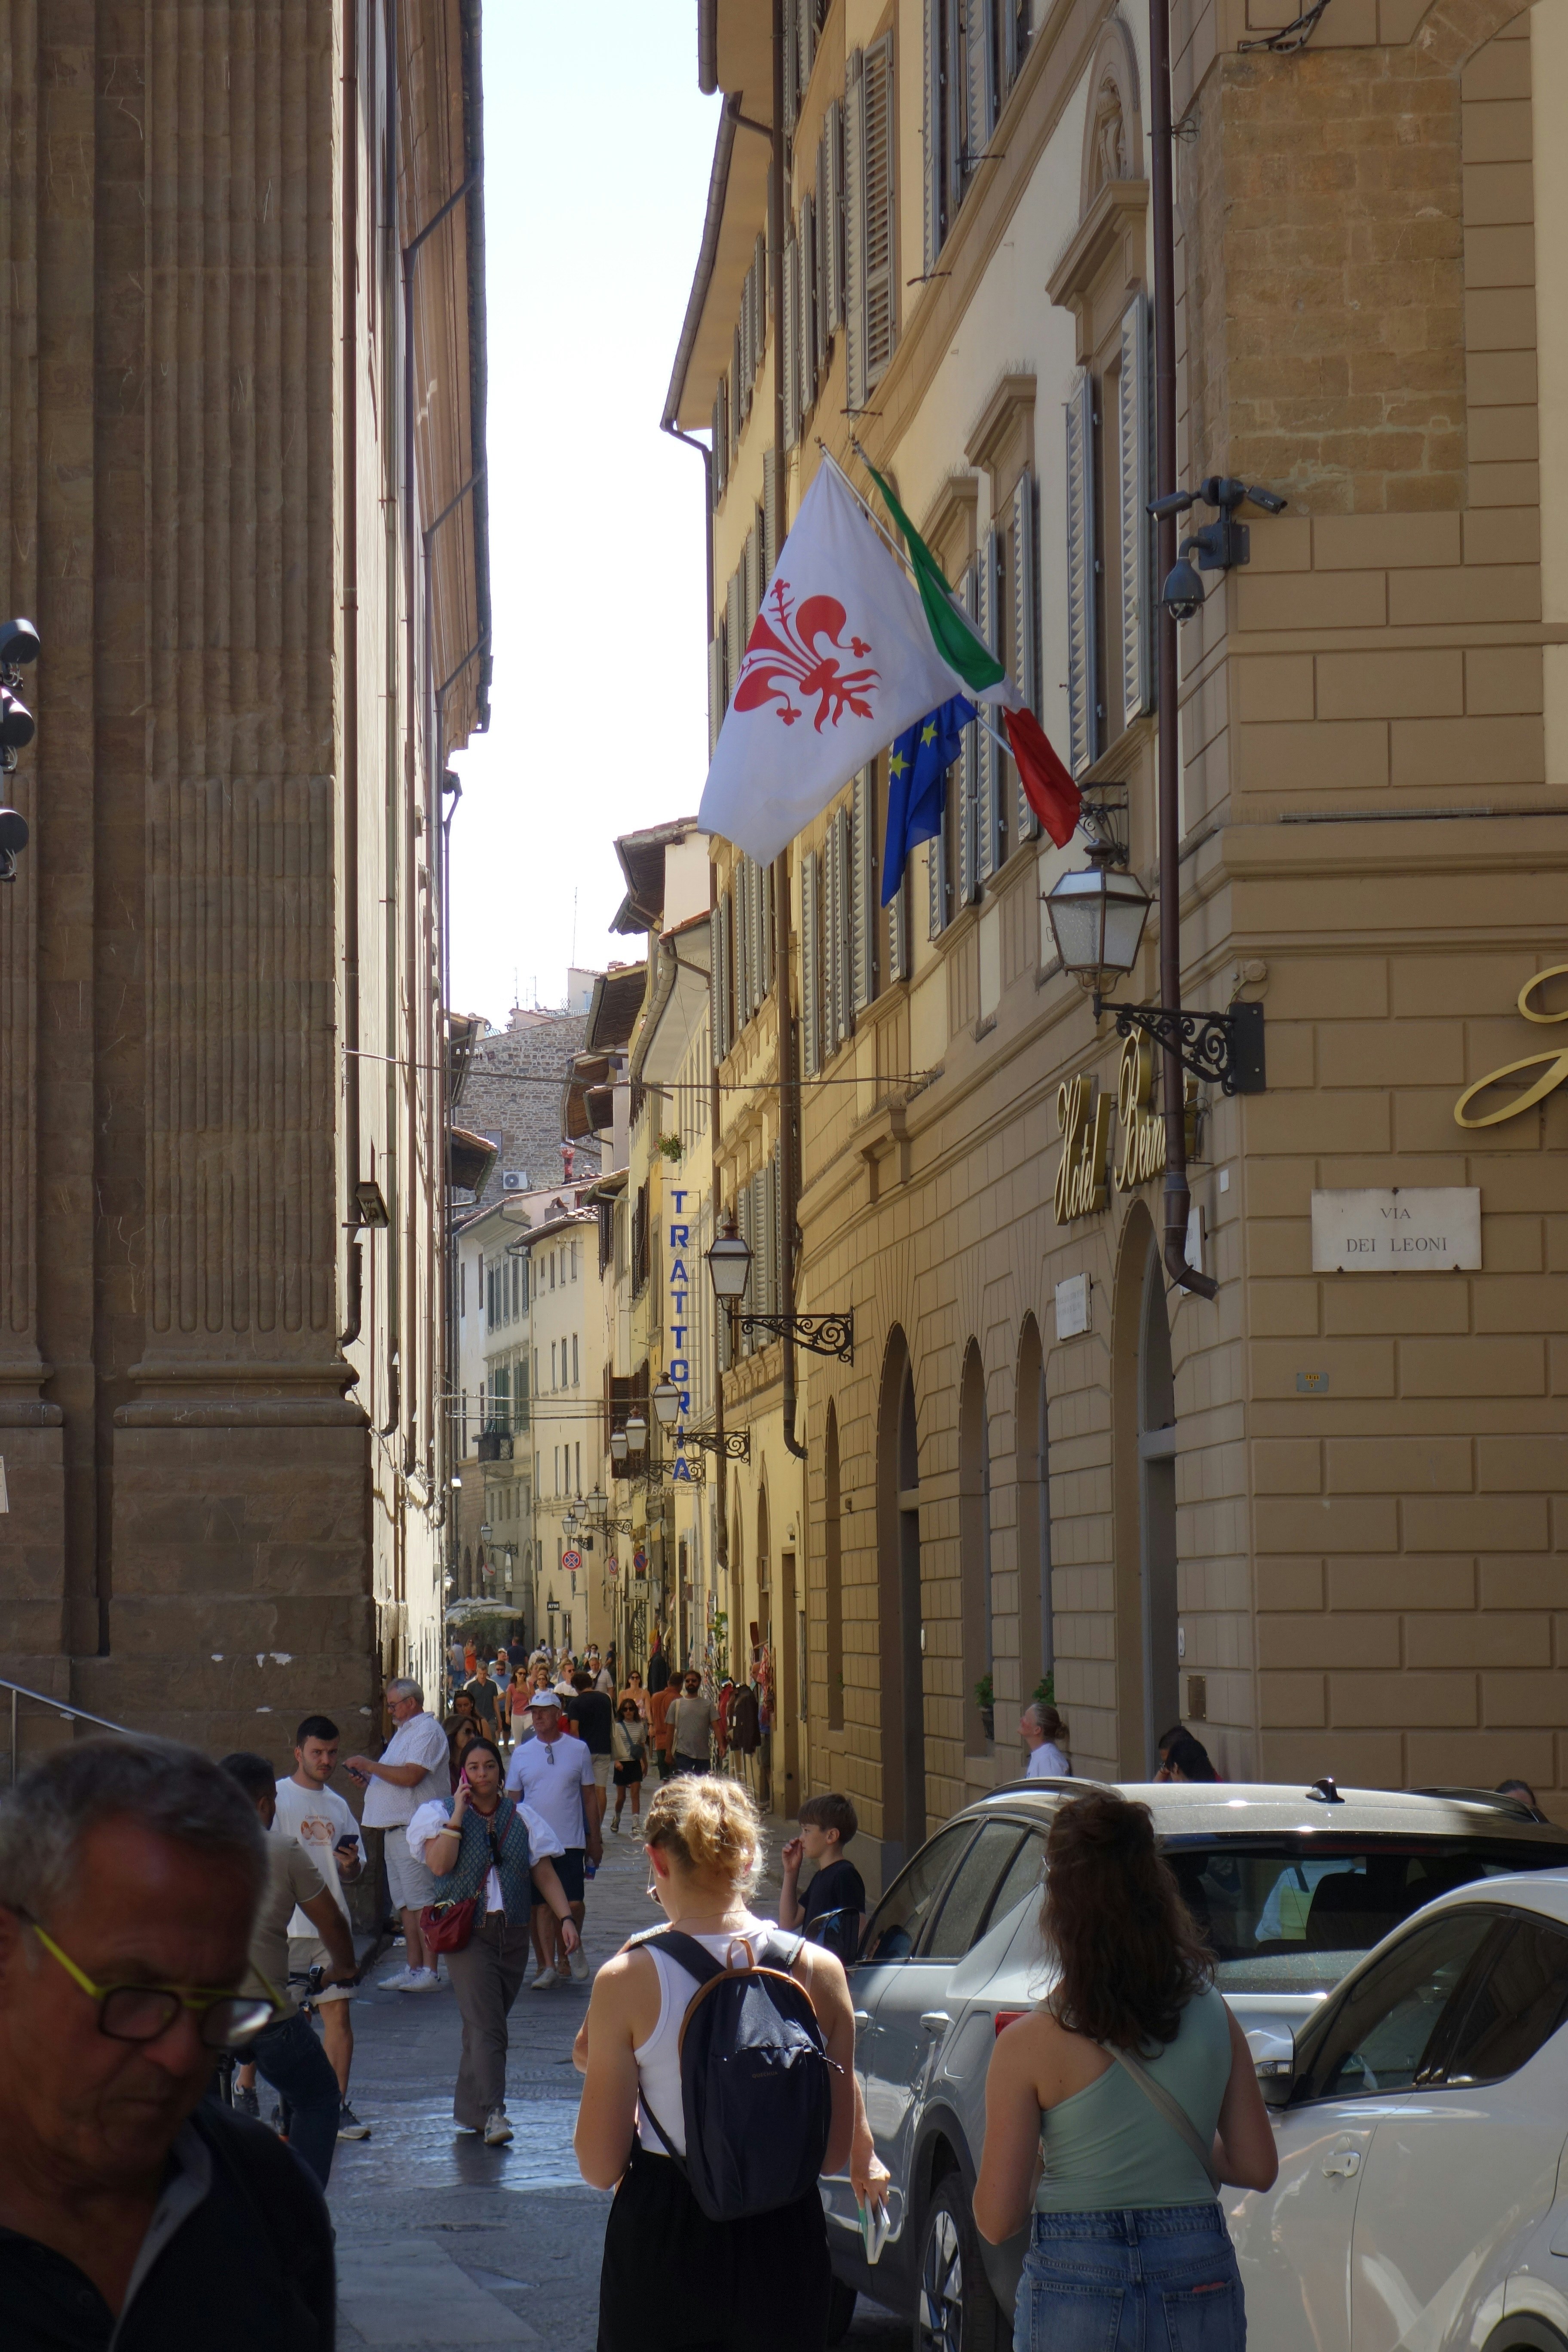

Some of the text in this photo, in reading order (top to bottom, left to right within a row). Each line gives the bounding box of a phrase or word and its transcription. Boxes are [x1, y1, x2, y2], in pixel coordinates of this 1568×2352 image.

[1054, 1026, 1191, 1225] Hotel Bern
[1347, 1237, 1447, 1252] DEI LEONI
[1380, 1208, 1411, 1219] VIA
[670, 1190, 691, 1480] TRATTORIA
